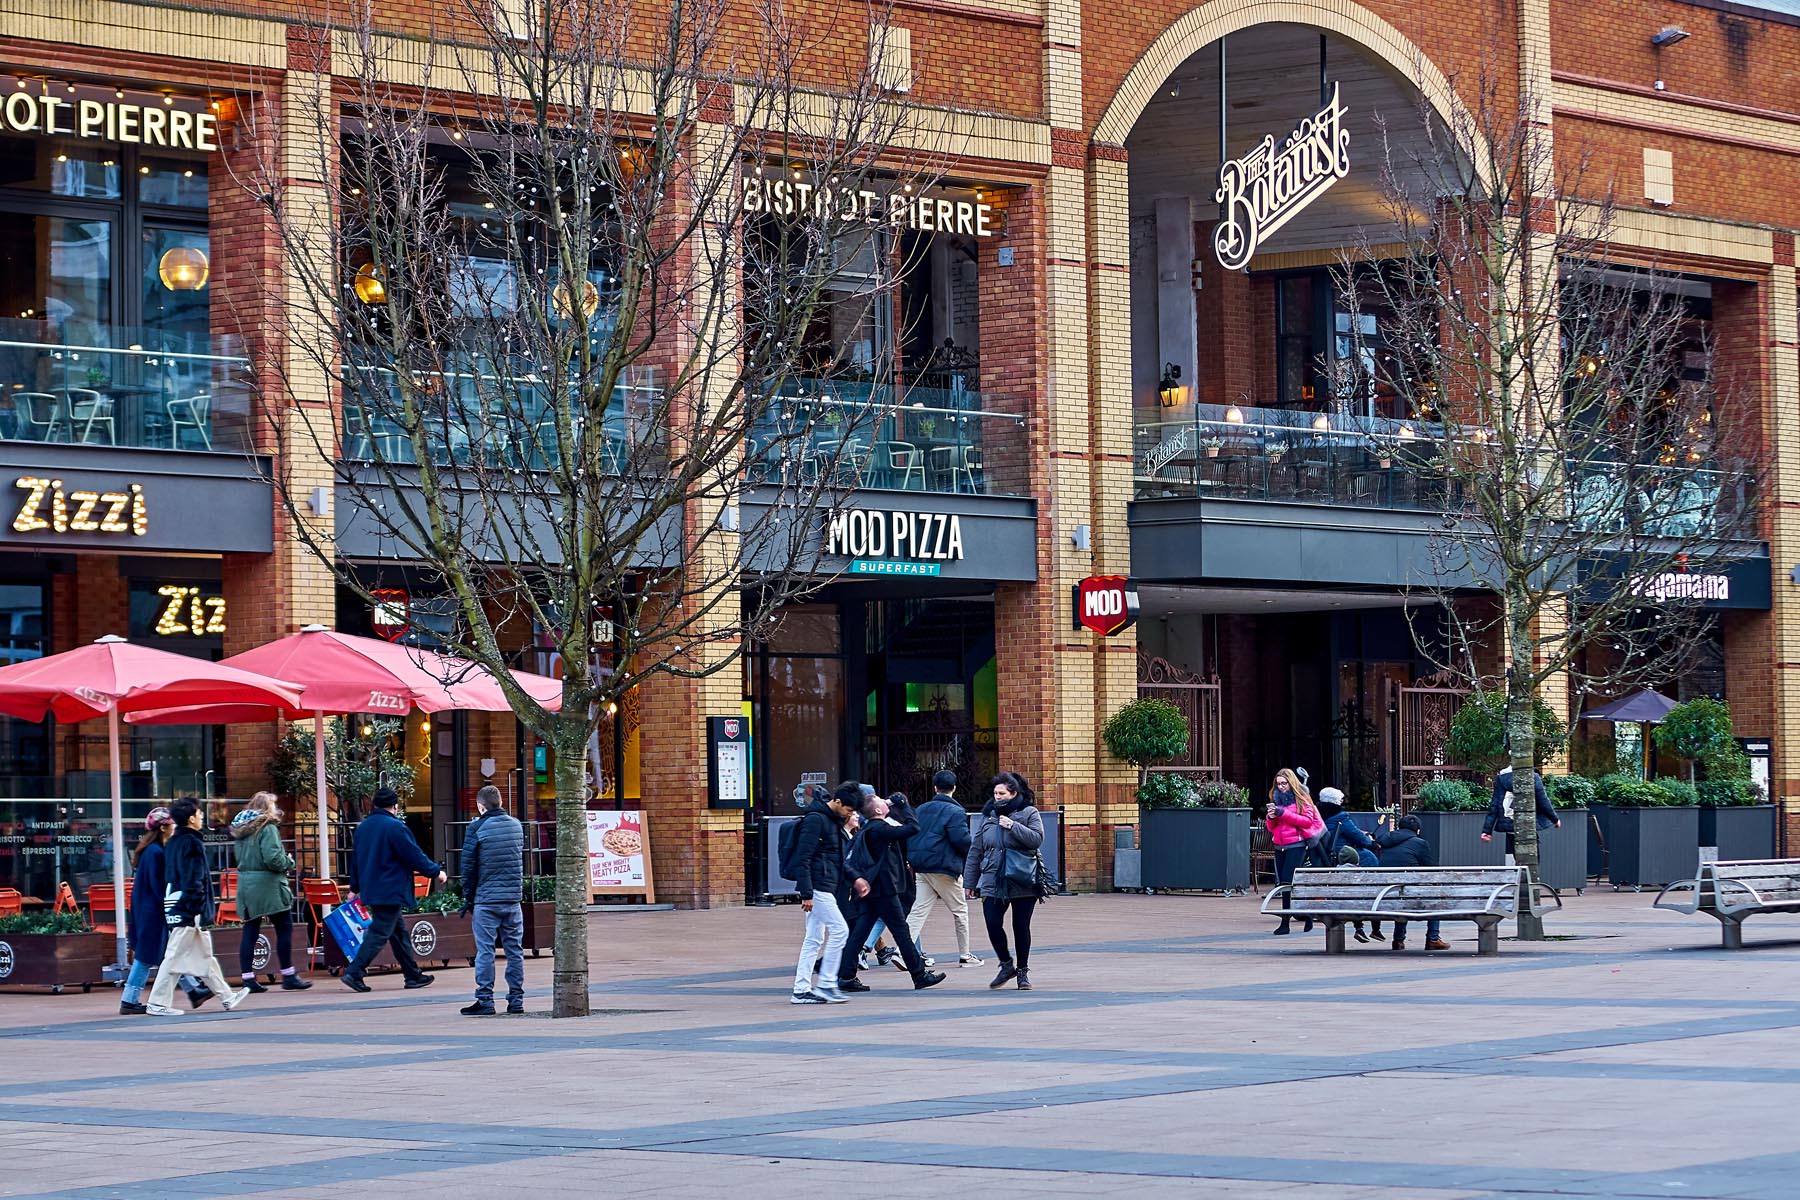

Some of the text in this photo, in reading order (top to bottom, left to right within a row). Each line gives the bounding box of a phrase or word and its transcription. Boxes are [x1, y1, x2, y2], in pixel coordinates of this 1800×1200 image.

[80, 99, 217, 151] PIERRE
[1215, 80, 1350, 270] Botanist
[890, 193, 992, 237] PIERRE
[13, 475, 148, 536] Zizzi
[828, 508, 964, 560] MOD PIZZA
[859, 562, 935, 575] SUPERFAST
[1085, 589, 1122, 617] MOD
[367, 690, 405, 709] Zizzi
[31, 821, 65, 830] ANTIPASTI
[22, 847, 56, 856] ESPRESSO
[592, 864, 631, 878] MEATY PIZZA
[414, 934, 432, 943] Zizzi
